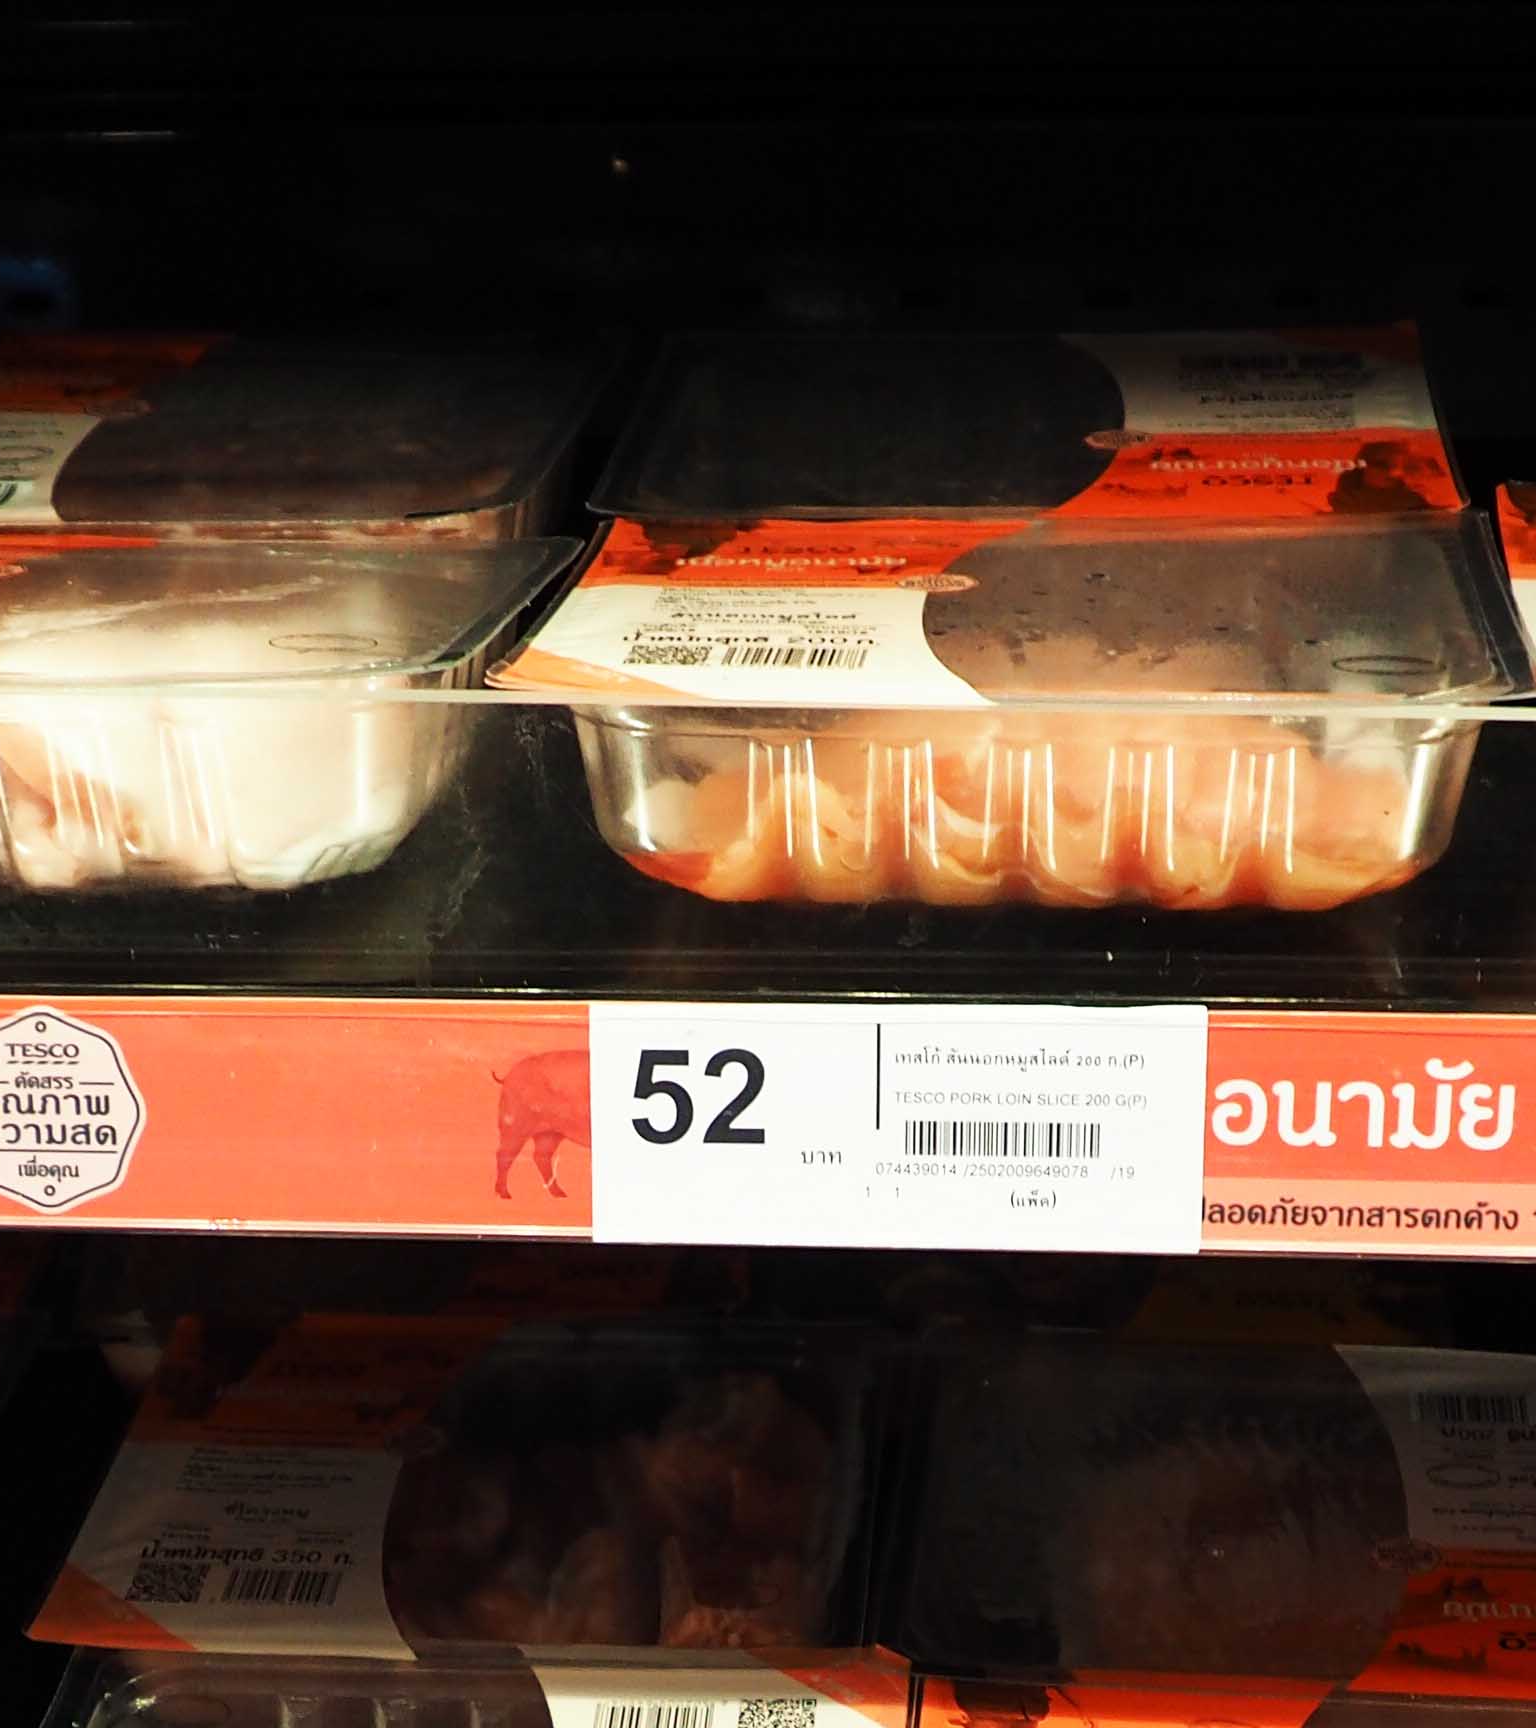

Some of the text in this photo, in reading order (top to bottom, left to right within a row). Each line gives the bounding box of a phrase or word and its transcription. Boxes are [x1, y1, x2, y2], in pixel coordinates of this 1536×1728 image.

[5, 1043, 79, 1058] TESCO
[1076, 1055, 1103, 1067] 200
[15, 1072, 74, 1090] คัดสรร
[632, 1047, 765, 1146] 52
[895, 1091, 1148, 1110] TESCO PORK LOIN SLICE 200 G(P)
[1212, 1058, 1516, 1152] อนามัย
[801, 1148, 843, 1166] บาท
[18, 1156, 79, 1183] เพื่อคุณ
[875, 1162, 958, 1177] 074439014
[1110, 1166, 1136, 1179] /19
[1010, 1188, 1058, 1210] (แพ็ค)
[273, 1550, 322, 1564] 350
